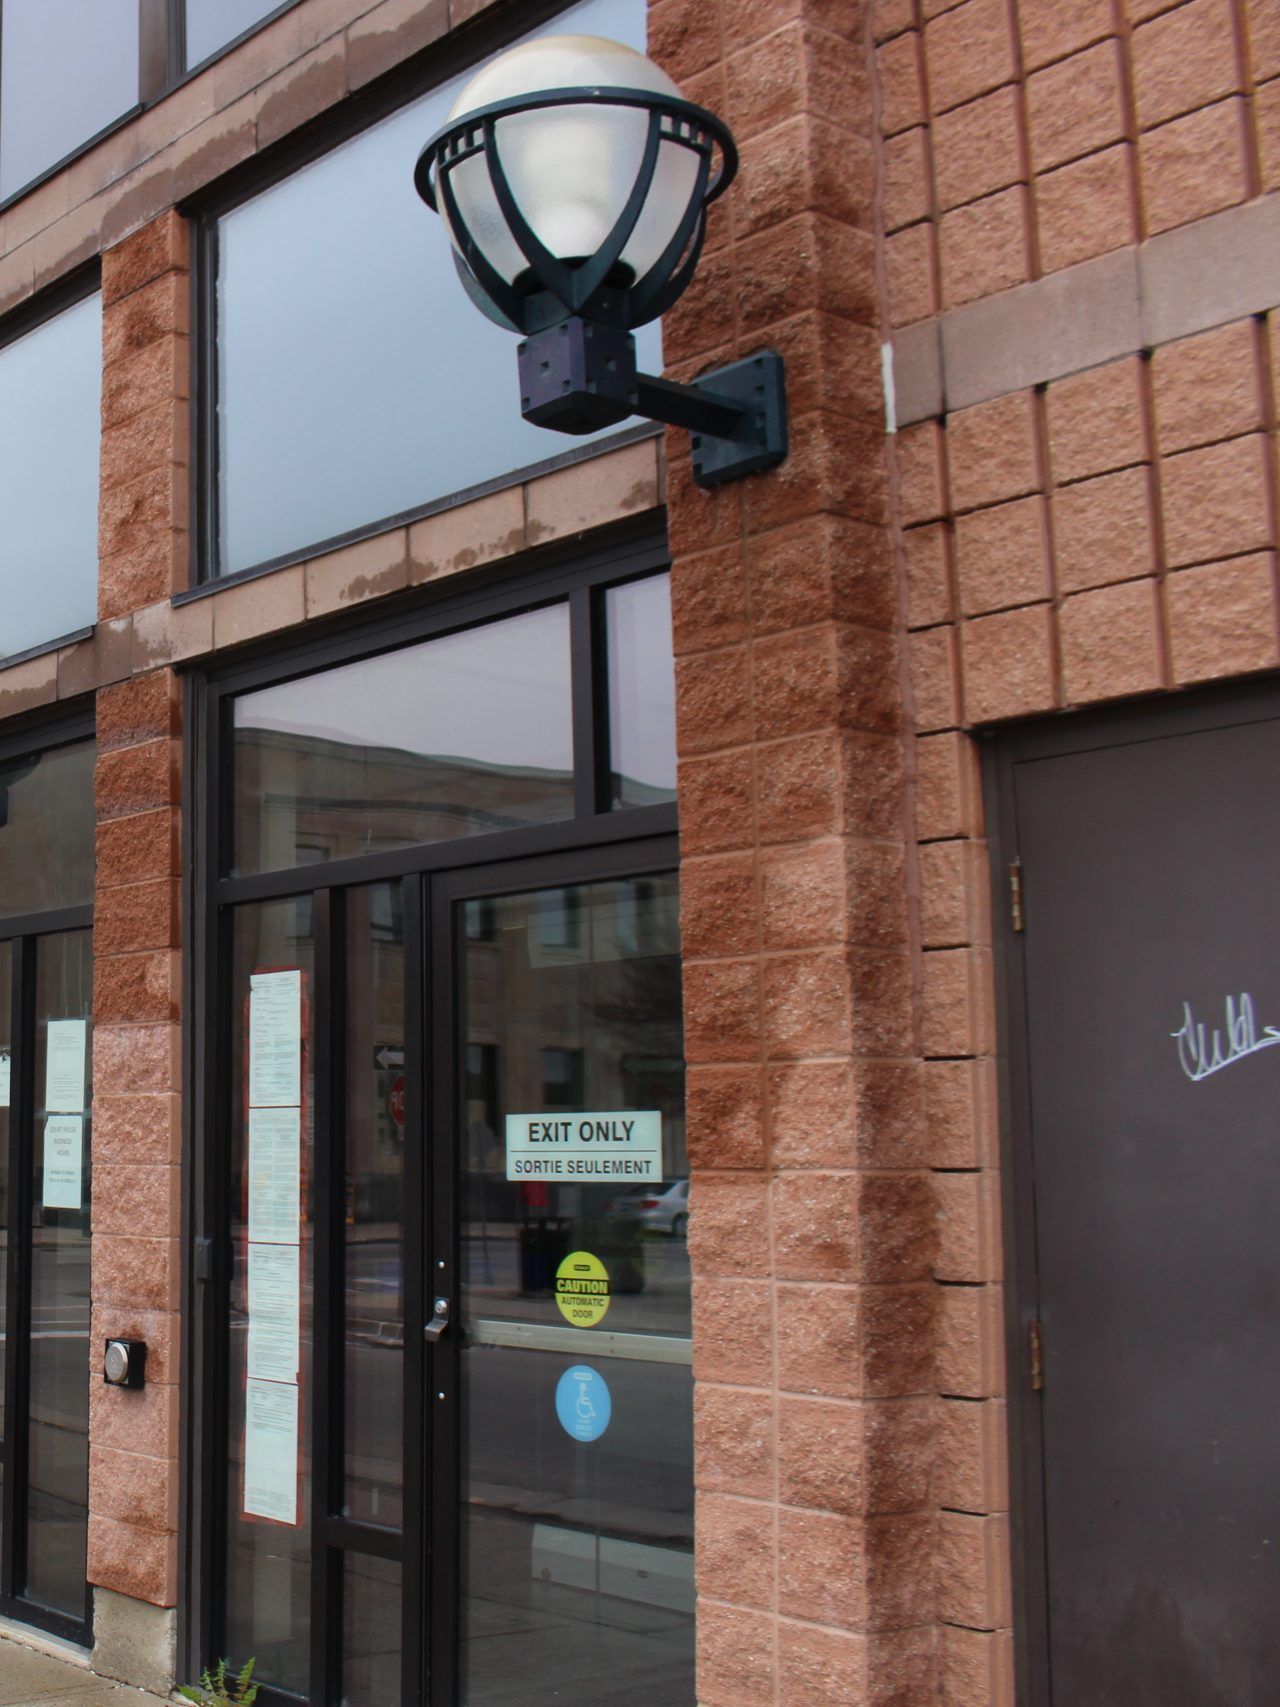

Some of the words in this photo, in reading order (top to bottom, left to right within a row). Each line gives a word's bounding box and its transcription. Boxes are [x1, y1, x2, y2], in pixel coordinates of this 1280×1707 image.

[528, 1121, 572, 1142] EXIT
[579, 1120, 635, 1142] ONLY
[515, 1160, 563, 1174] SORTIE
[567, 1160, 652, 1174] SEULEMENT
[556, 1278, 609, 1294] CAUTION
[562, 1296, 604, 1307] AUTOMATIC
[572, 1309, 594, 1319] DOOR
